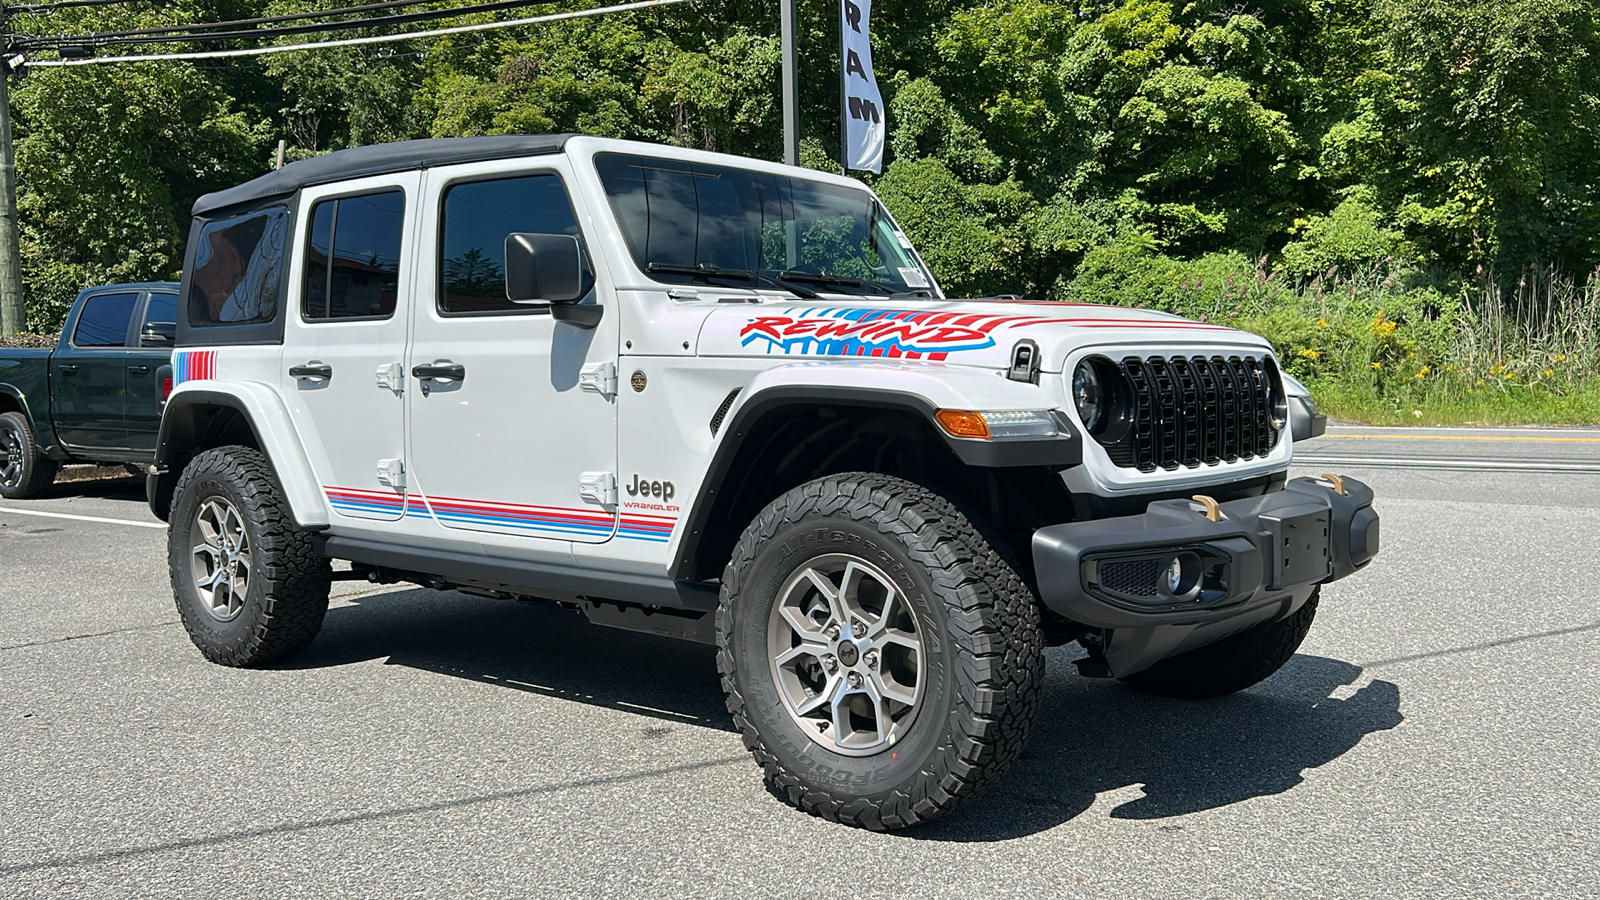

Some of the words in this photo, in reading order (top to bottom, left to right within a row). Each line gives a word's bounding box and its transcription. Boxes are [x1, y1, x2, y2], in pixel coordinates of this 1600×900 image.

[845, 0, 881, 124] RAM
[740, 317, 988, 343] REWIND
[626, 474, 675, 503] Jeep
[624, 501, 680, 513] WRANGLER
[777, 527, 916, 590] All-Terrain
